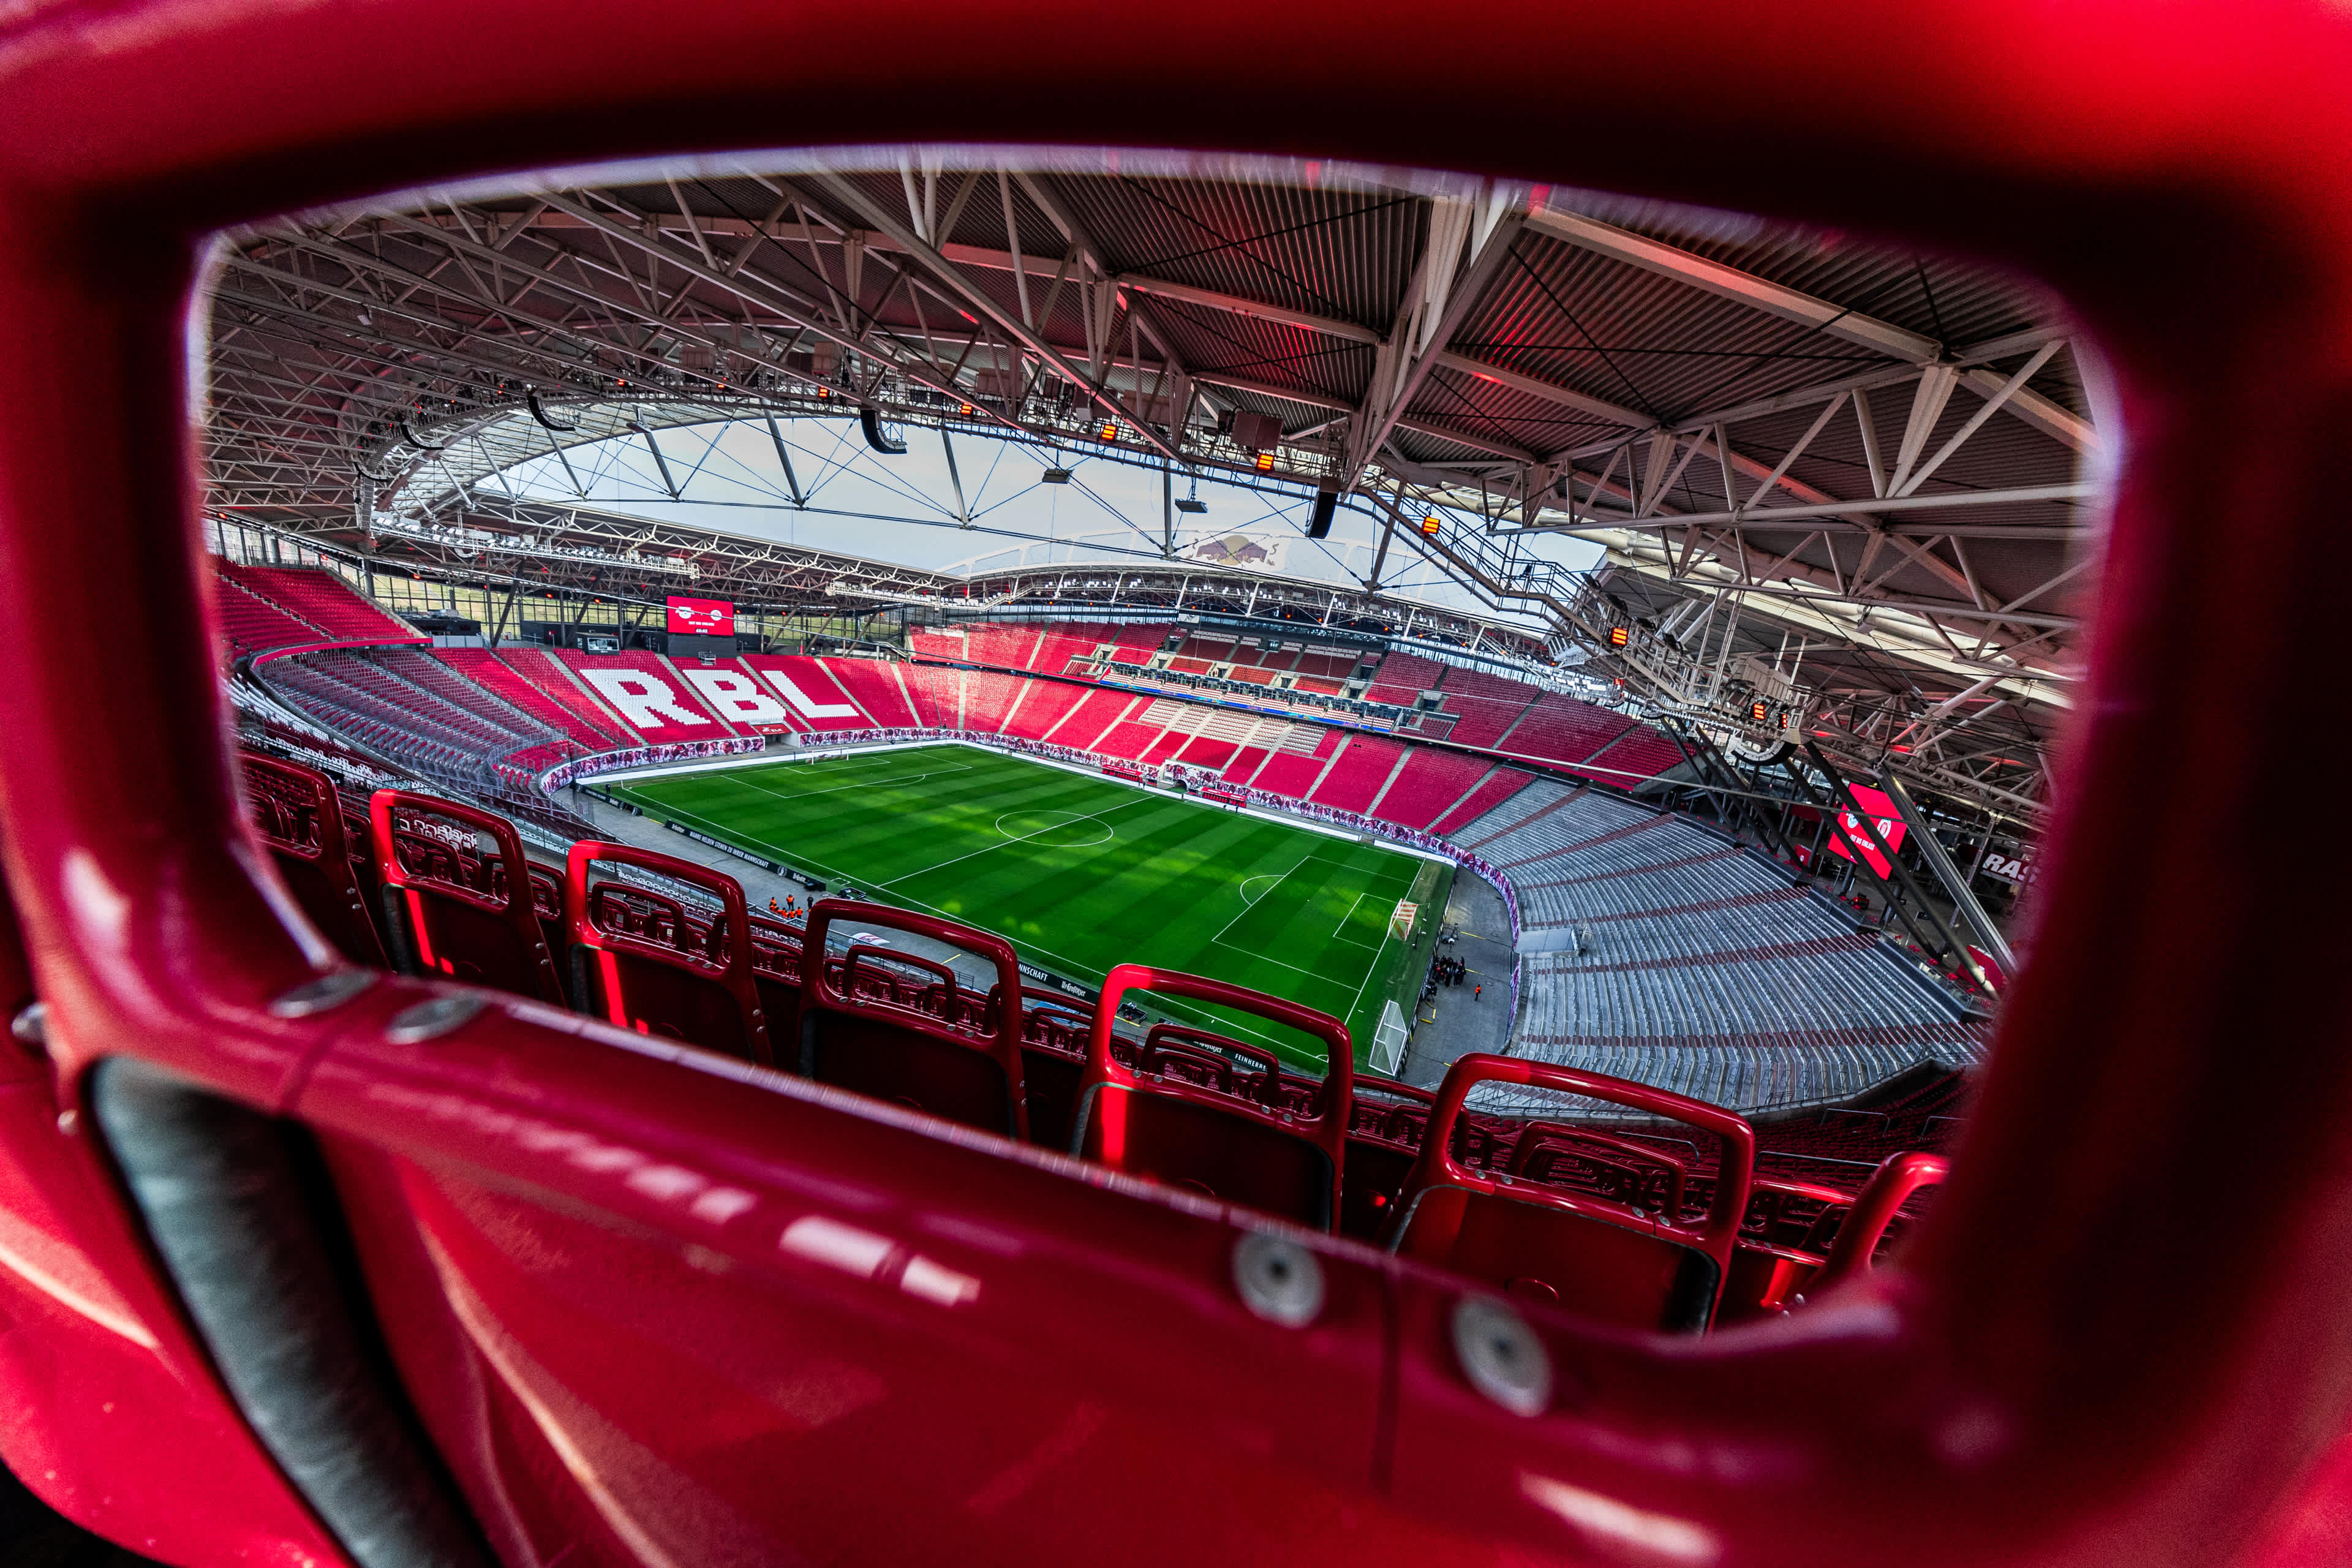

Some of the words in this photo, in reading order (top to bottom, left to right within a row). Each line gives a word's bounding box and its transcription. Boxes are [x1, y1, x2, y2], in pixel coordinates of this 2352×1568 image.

[579, 669, 859, 728] RBL
[690, 831, 702, 840] WAHRE
[701, 836, 715, 845] HELDEN
[714, 841, 728, 851] STEHEN
[744, 853, 769, 868] MANNSCHAFT
[1019, 963, 1048, 982] NNSCHAFT
